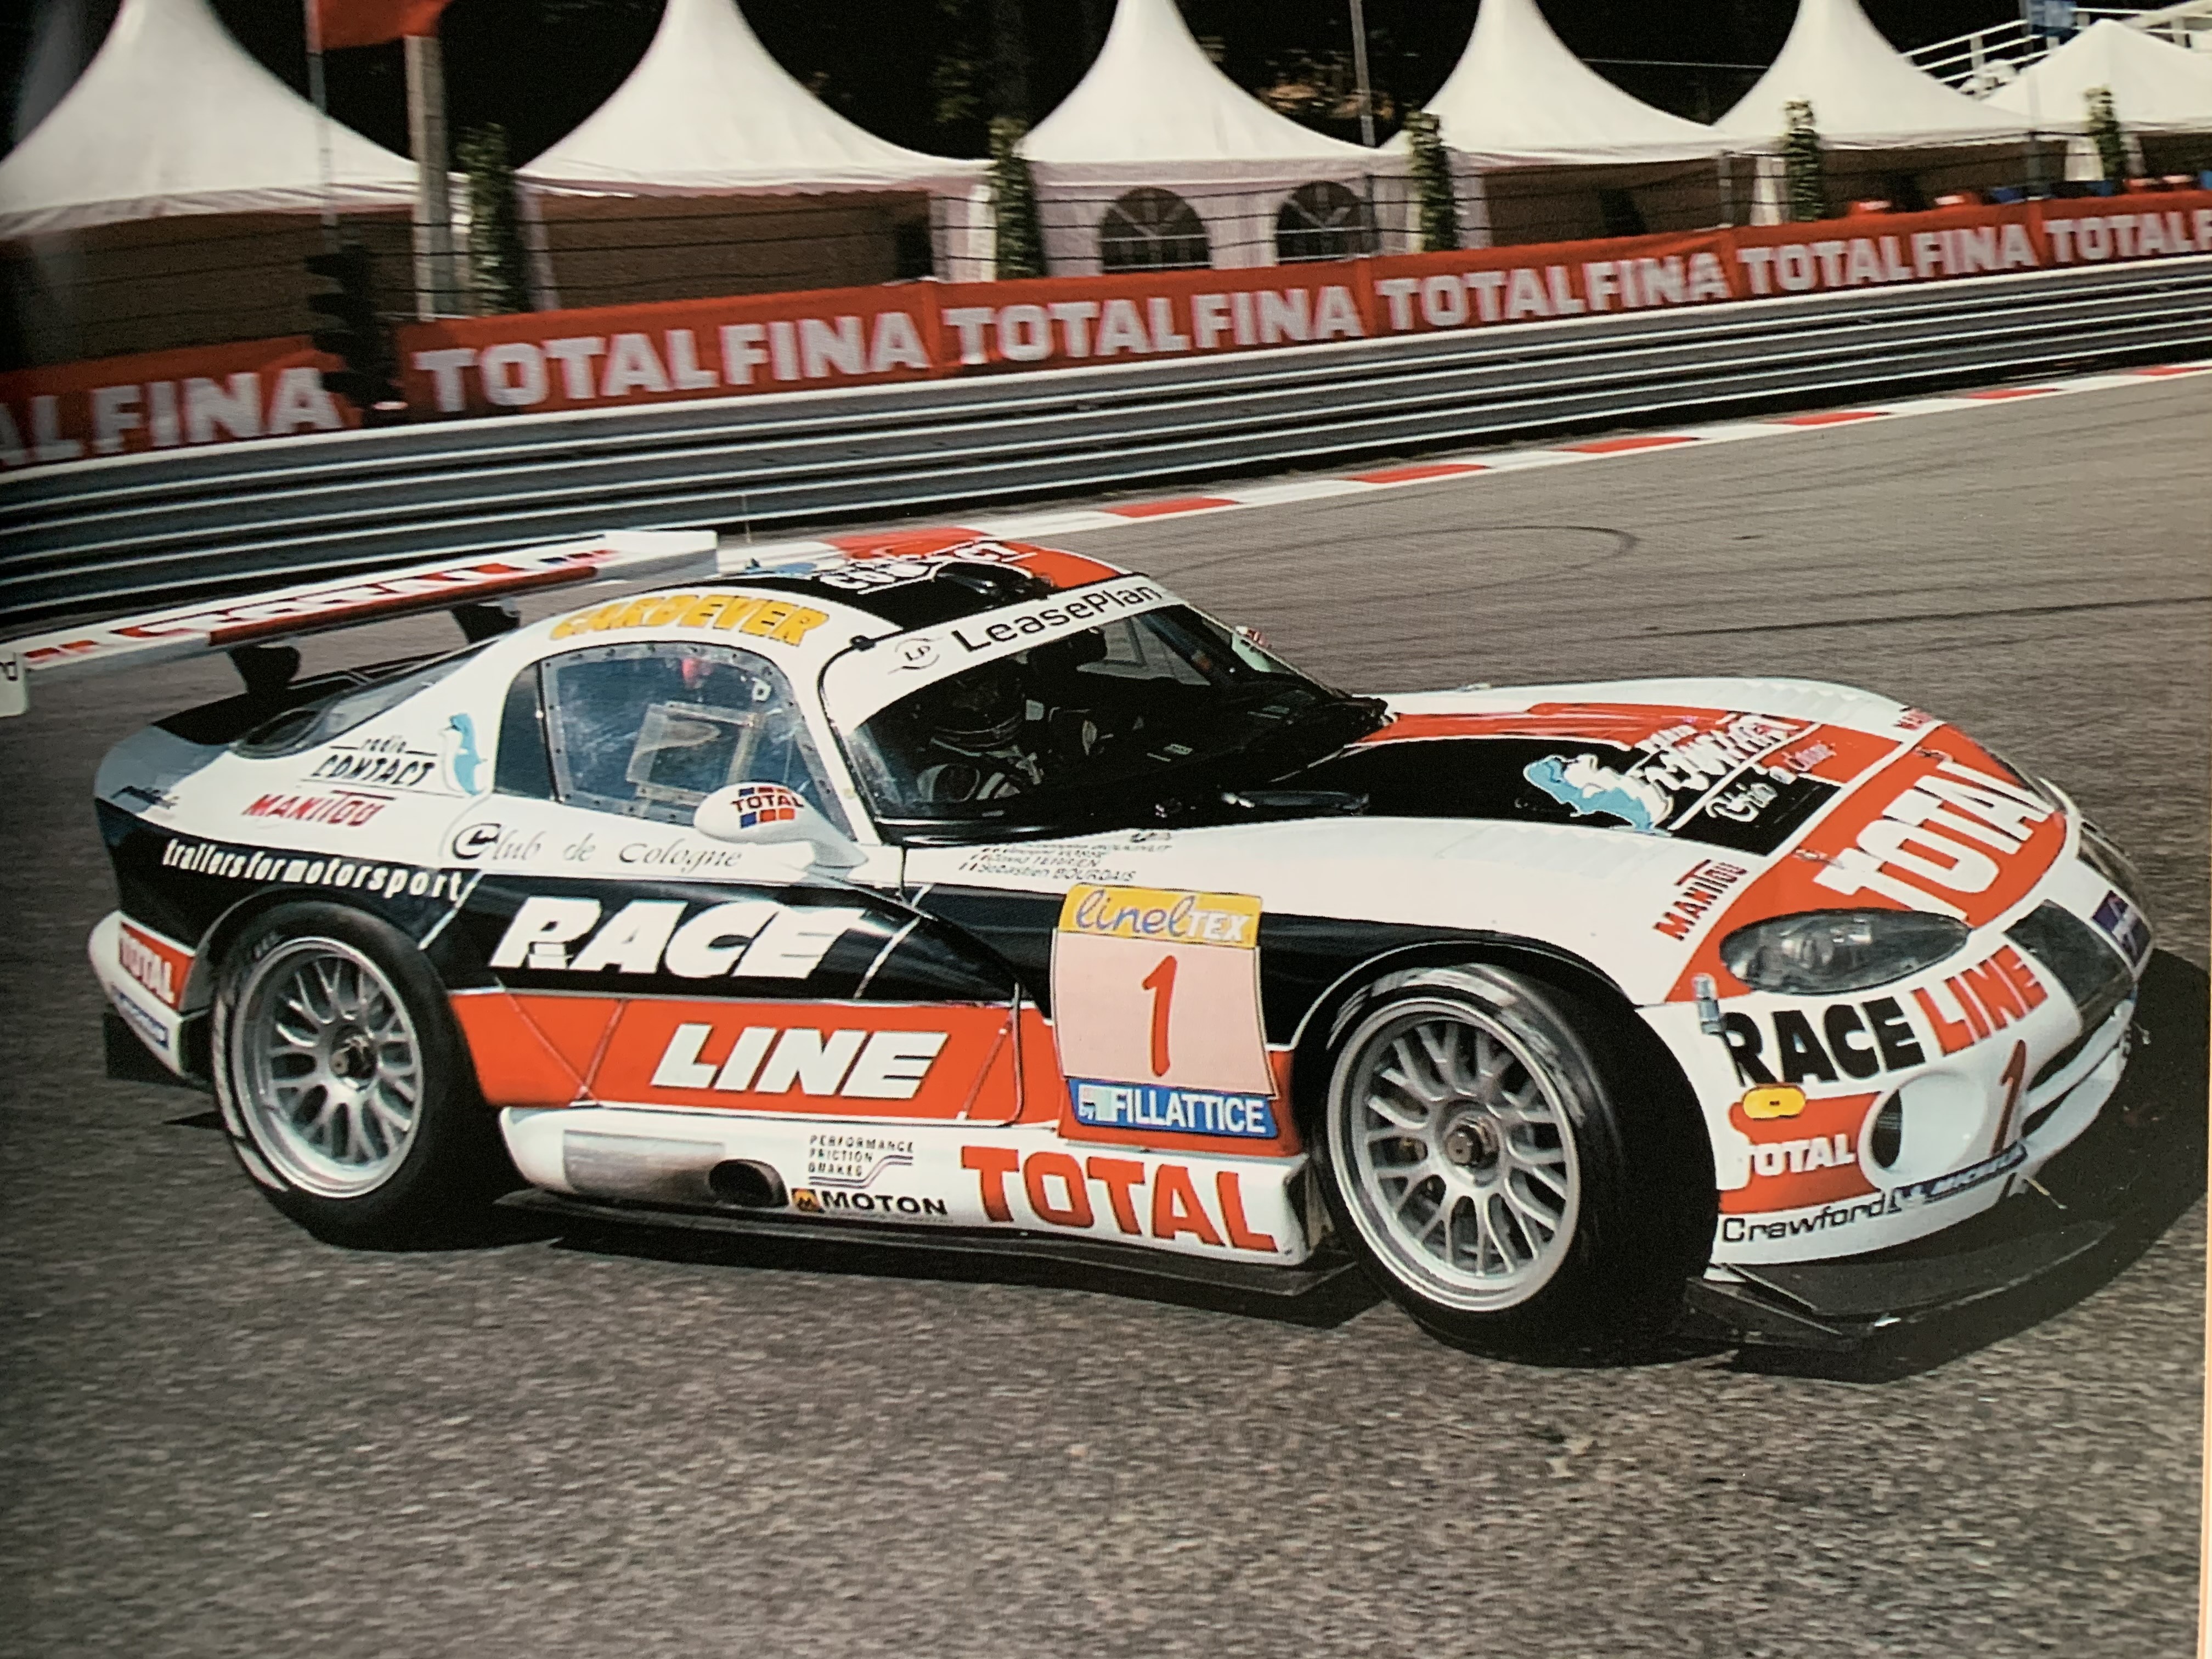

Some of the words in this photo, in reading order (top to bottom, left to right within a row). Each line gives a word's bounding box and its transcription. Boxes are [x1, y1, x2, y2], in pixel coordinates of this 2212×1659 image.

[951, 586, 1162, 652] LeasePlan
[240, 790, 397, 826] MANITOU
[731, 795, 804, 812] TOTAL
[1652, 859, 1748, 941] MANITOU
[489, 895, 867, 979] RACE
[1141, 955, 1178, 1077] 1
[651, 1023, 949, 1099] LINE
[1991, 1039, 2027, 1155] 1
[809, 1135, 913, 1153] PERFORMANCE
[821, 1190, 949, 1216] MOTON
[961, 1146, 1278, 1252] TOTAL
[1723, 1193, 1886, 1242] Crawford
